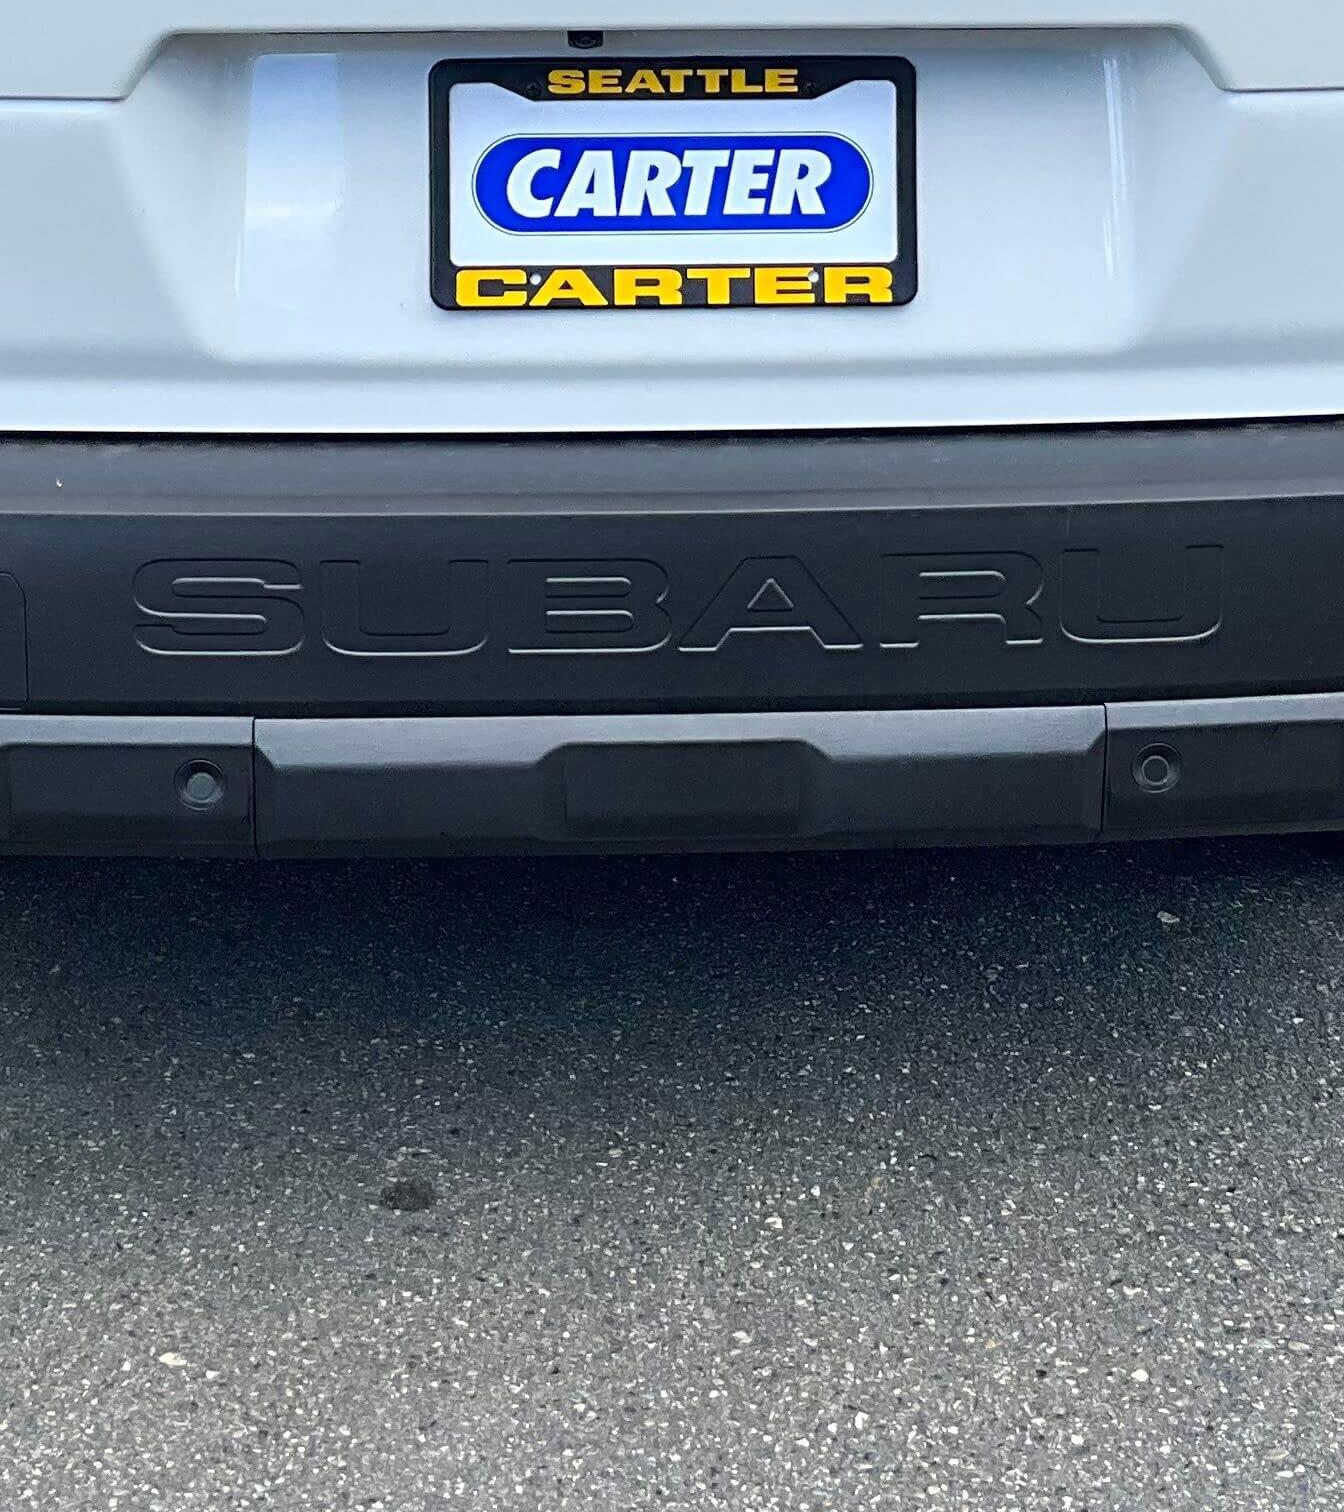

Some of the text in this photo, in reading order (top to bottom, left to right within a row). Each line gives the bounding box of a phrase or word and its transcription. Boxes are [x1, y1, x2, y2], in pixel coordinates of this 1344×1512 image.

[547, 68, 798, 95] SEATTLE
[506, 148, 832, 219] CARTER
[456, 267, 893, 307] CARTER
[132, 543, 1224, 656] SUBARU
